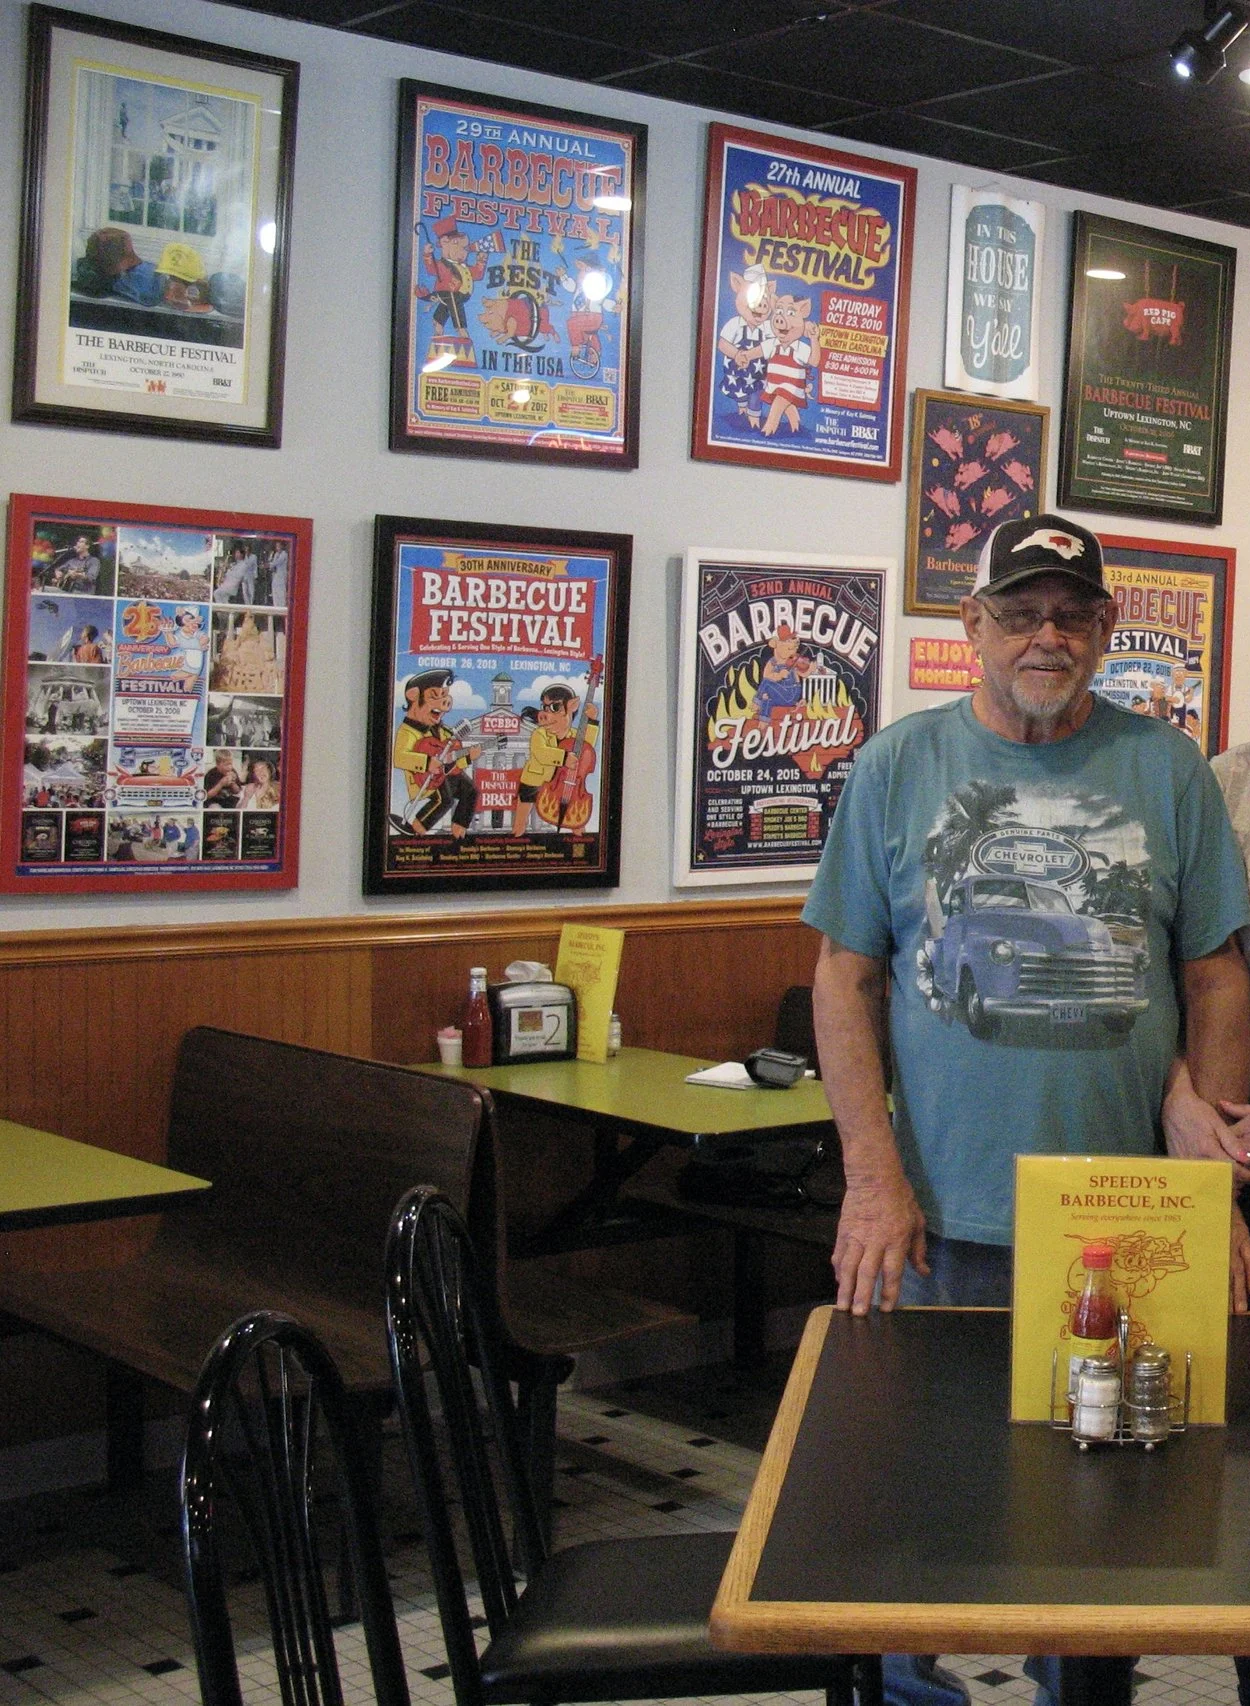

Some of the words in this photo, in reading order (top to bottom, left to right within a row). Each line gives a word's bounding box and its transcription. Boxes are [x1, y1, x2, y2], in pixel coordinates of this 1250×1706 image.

[456, 120, 503, 140] 29TH
[507, 130, 596, 158] ANNUAL
[424, 133, 622, 216] BARBECUE
[767, 161, 801, 185] 27th
[803, 169, 861, 199] ANNUAL
[423, 191, 621, 245] FESTIVAL
[738, 189, 887, 264] BARBECUE
[976, 223, 991, 238] IN
[511, 239, 540, 262] THE
[755, 237, 865, 286] FESTIVAL
[967, 244, 1029, 292] HOUSE
[487, 264, 561, 296] BEST
[828, 297, 882, 318] SATURDAY
[973, 292, 996, 308] WE
[826, 312, 844, 324] OCT.
[846, 316, 858, 328] 23,
[860, 318, 883, 331] 2010
[1144, 308, 1160, 316] RED
[1162, 309, 1176, 319] PIG
[1151, 316, 1171, 326] CAFE
[76, 334, 104, 348] THE
[108, 338, 177, 357] BARBECUE
[181, 347, 237, 365] FESTIVAL
[481, 349, 498, 371] IN
[502, 352, 532, 374] THE
[536, 356, 564, 378] USA
[828, 352, 843, 361] FREE
[843, 354, 877, 366] ADMISSION
[840, 363, 850, 372] AM
[869, 368, 879, 376] PM
[425, 386, 449, 402] FREE
[1084, 384, 1152, 410] BARBECUE
[1156, 397, 1210, 420] FESTIVAL
[531, 401, 548, 413] 2012
[1103, 408, 1135, 421] UPTOWN
[1136, 412, 1178, 429] LEXINGTON,
[1180, 420, 1192, 430] NC
[852, 425, 880, 440] BB&T
[460, 560, 484, 572] 30TH
[486, 560, 553, 577] ANNIVERSARY
[1110, 570, 1133, 584] 33rd
[1136, 573, 1178, 588] ANNUAL
[422, 572, 588, 613] BARBECUE
[751, 580, 783, 597] 32ND
[788, 581, 832, 601] ANNUAL
[1107, 583, 1208, 644] RBECUE
[429, 609, 581, 649] FESTIVAL
[699, 598, 880, 669] BARBECUE
[419, 644, 451, 652] Celebrating
[914, 641, 974, 664] ENJOY
[1110, 630, 1185, 658] ESTIVAL
[418, 656, 457, 668] OCTOBER
[477, 659, 497, 670] 2013
[559, 662, 571, 672] NC
[1110, 662, 1141, 674] OCTOBER
[1143, 662, 1154, 674] 22,
[1156, 664, 1171, 676] 2016
[913, 668, 969, 686] MOMENT
[121, 680, 183, 692] FESTIVAL
[484, 717, 519, 729] TCBBQ
[712, 705, 859, 770] Festival
[491, 771, 506, 781] THE
[707, 770, 752, 782] OCTOBER
[757, 769, 774, 782] 24,
[777, 769, 800, 780] 2015
[481, 780, 517, 791] DISPATCH
[741, 785, 773, 794] UPTOWN
[776, 784, 819, 794] LEXINGTON,
[821, 784, 831, 792] NC
[481, 793, 515, 807] BB&T
[1000, 827, 1036, 838] GENUINE
[994, 850, 1066, 865] CHEVROLET
[1052, 1007, 1085, 1019] CHEVY
[544, 1014, 561, 1046] 2
[1089, 1175, 1167, 1189] SPEEDY'S
[1060, 1194, 1155, 1210] BARBECUE,
[1160, 1196, 1195, 1209] INC.
